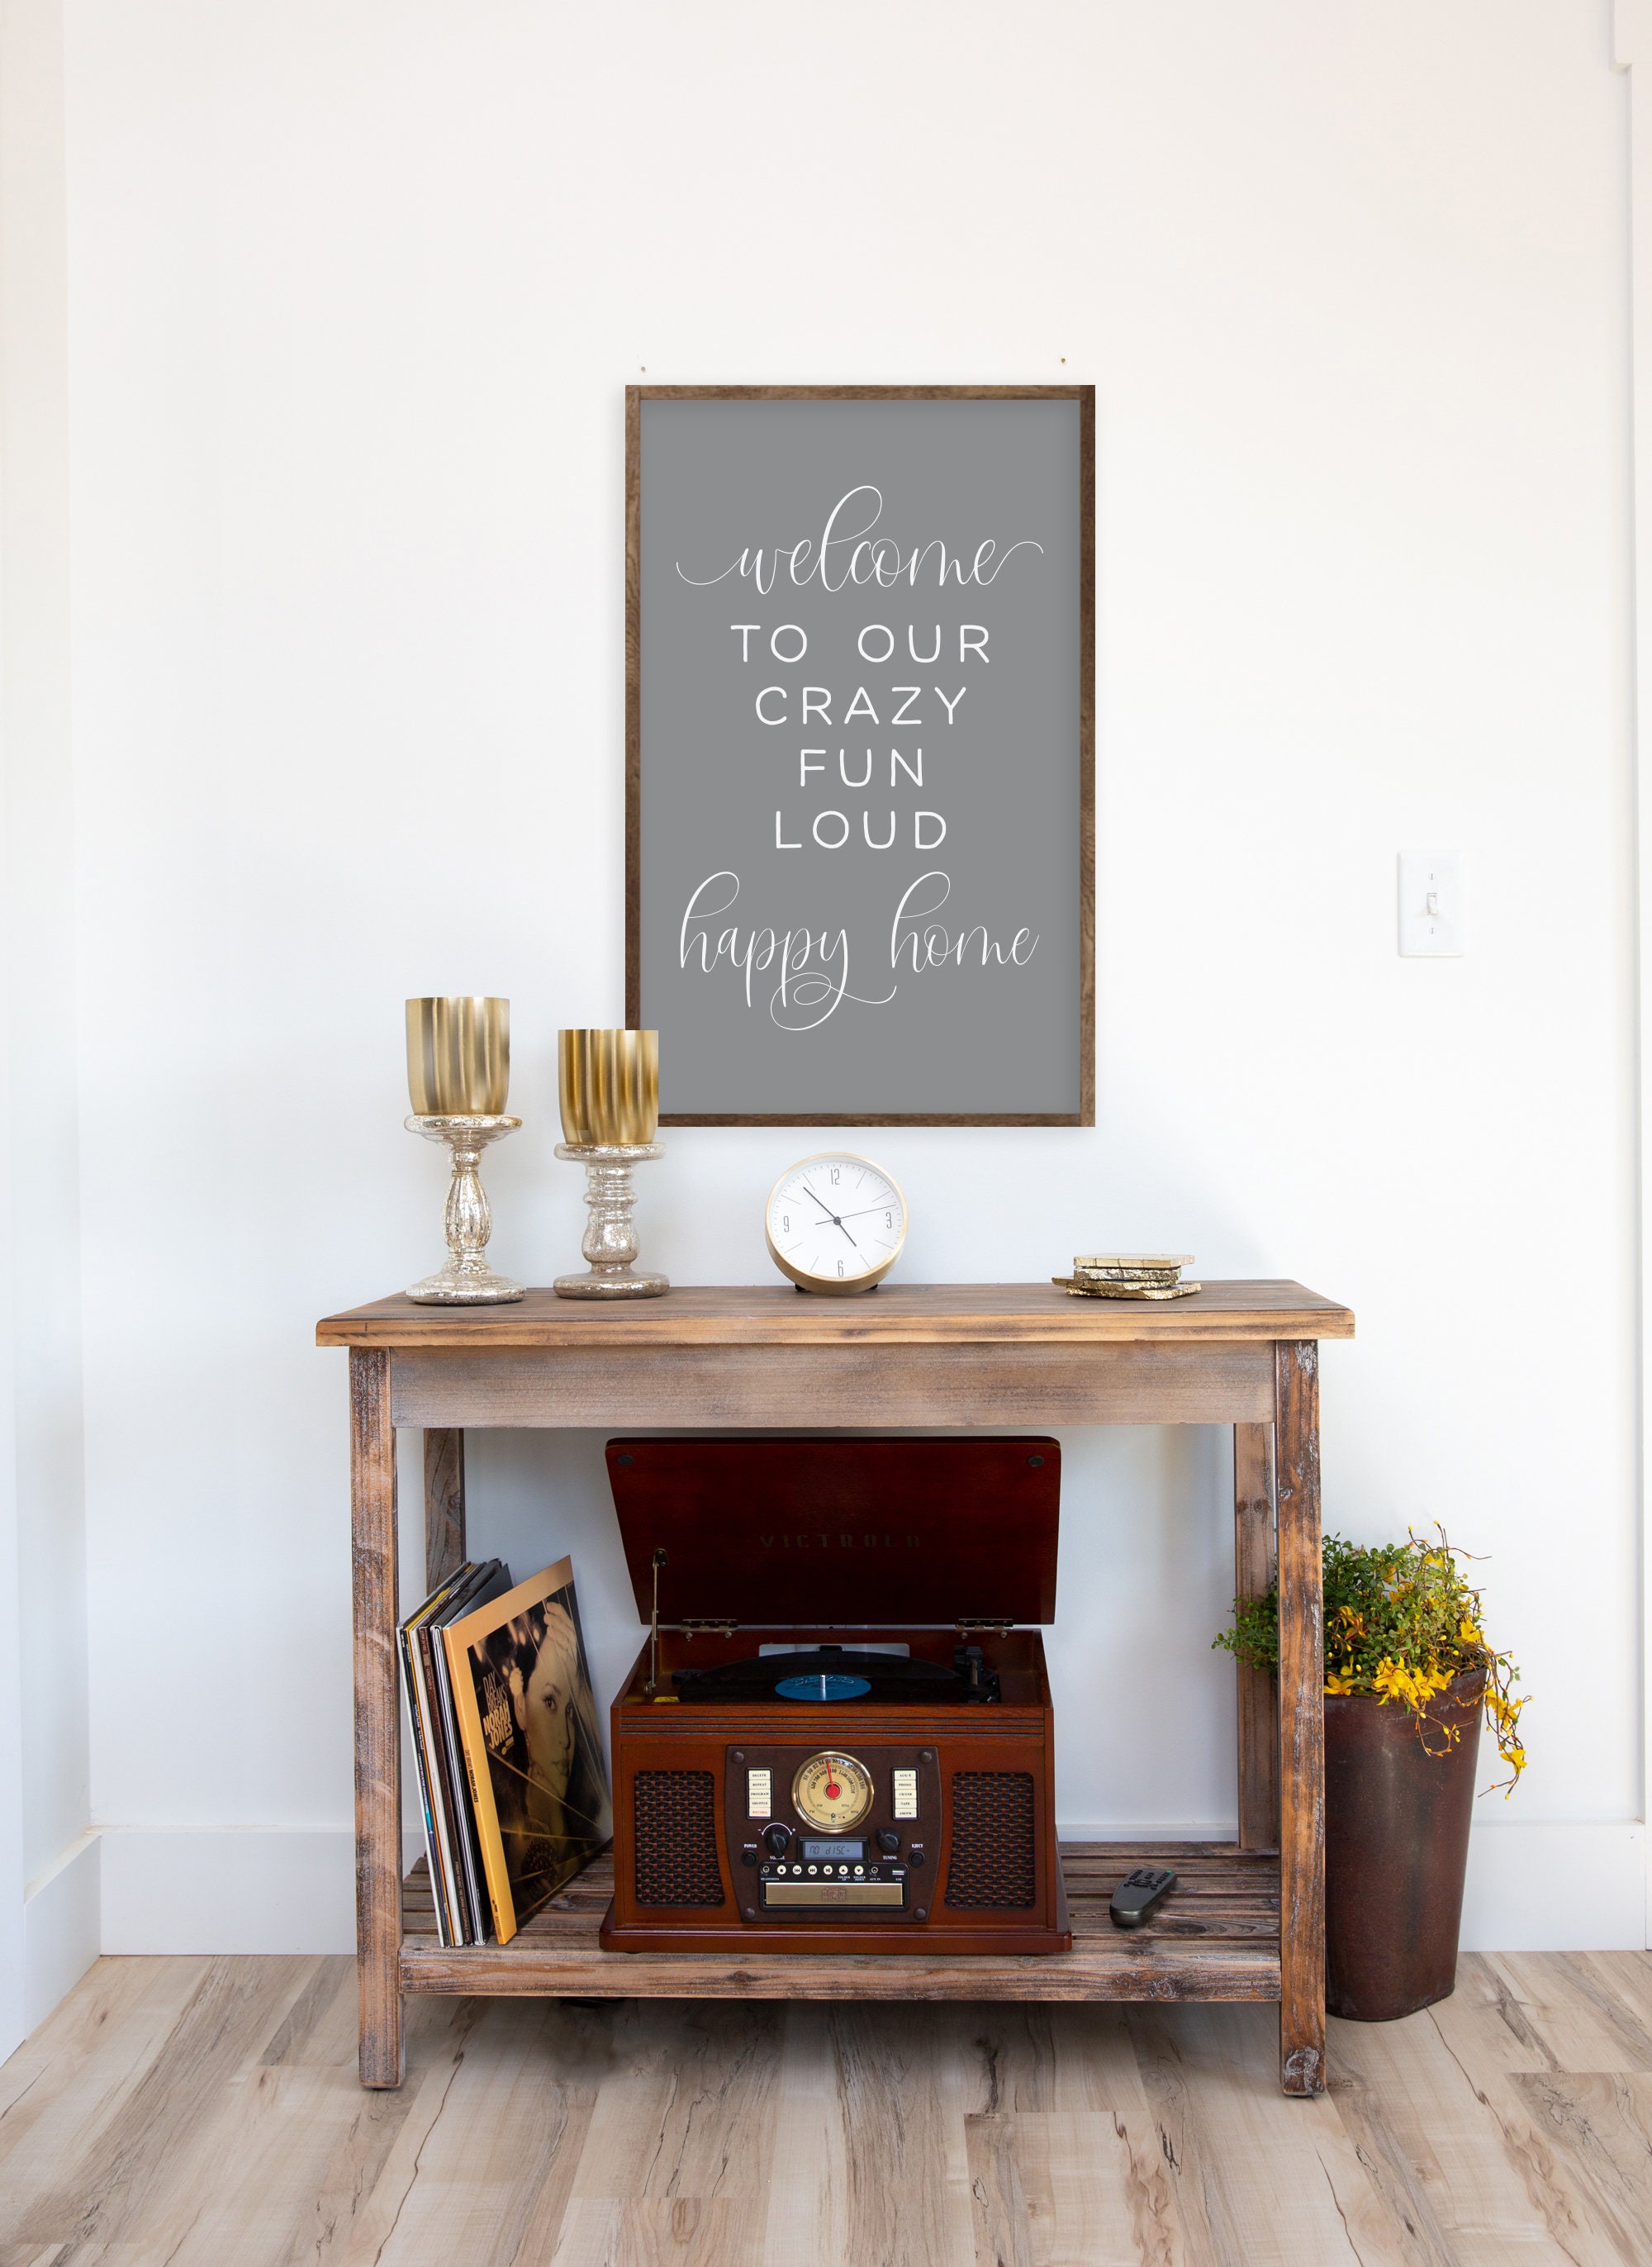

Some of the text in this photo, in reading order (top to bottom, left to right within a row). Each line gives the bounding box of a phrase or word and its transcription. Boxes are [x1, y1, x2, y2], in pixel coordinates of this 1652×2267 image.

[676, 486, 1043, 594] welcome
[730, 625, 990, 663] TO OUR
[756, 687, 966, 725] CRAZY
[800, 749, 923, 787] FUN
[776, 810, 946, 849] LOUD
[681, 872, 1039, 1030] happy home
[830, 1168, 840, 1186] 12
[783, 1215, 790, 1233] 9
[885, 1212, 892, 1229] 3
[838, 1260, 844, 1276] 6
[759, 1533, 920, 1547] VICTROLA
[482, 1671, 496, 1694] DAY
[486, 1684, 508, 1713] BREAKS
[482, 1700, 511, 1736] NORAH
[489, 1721, 513, 1750] JONES
